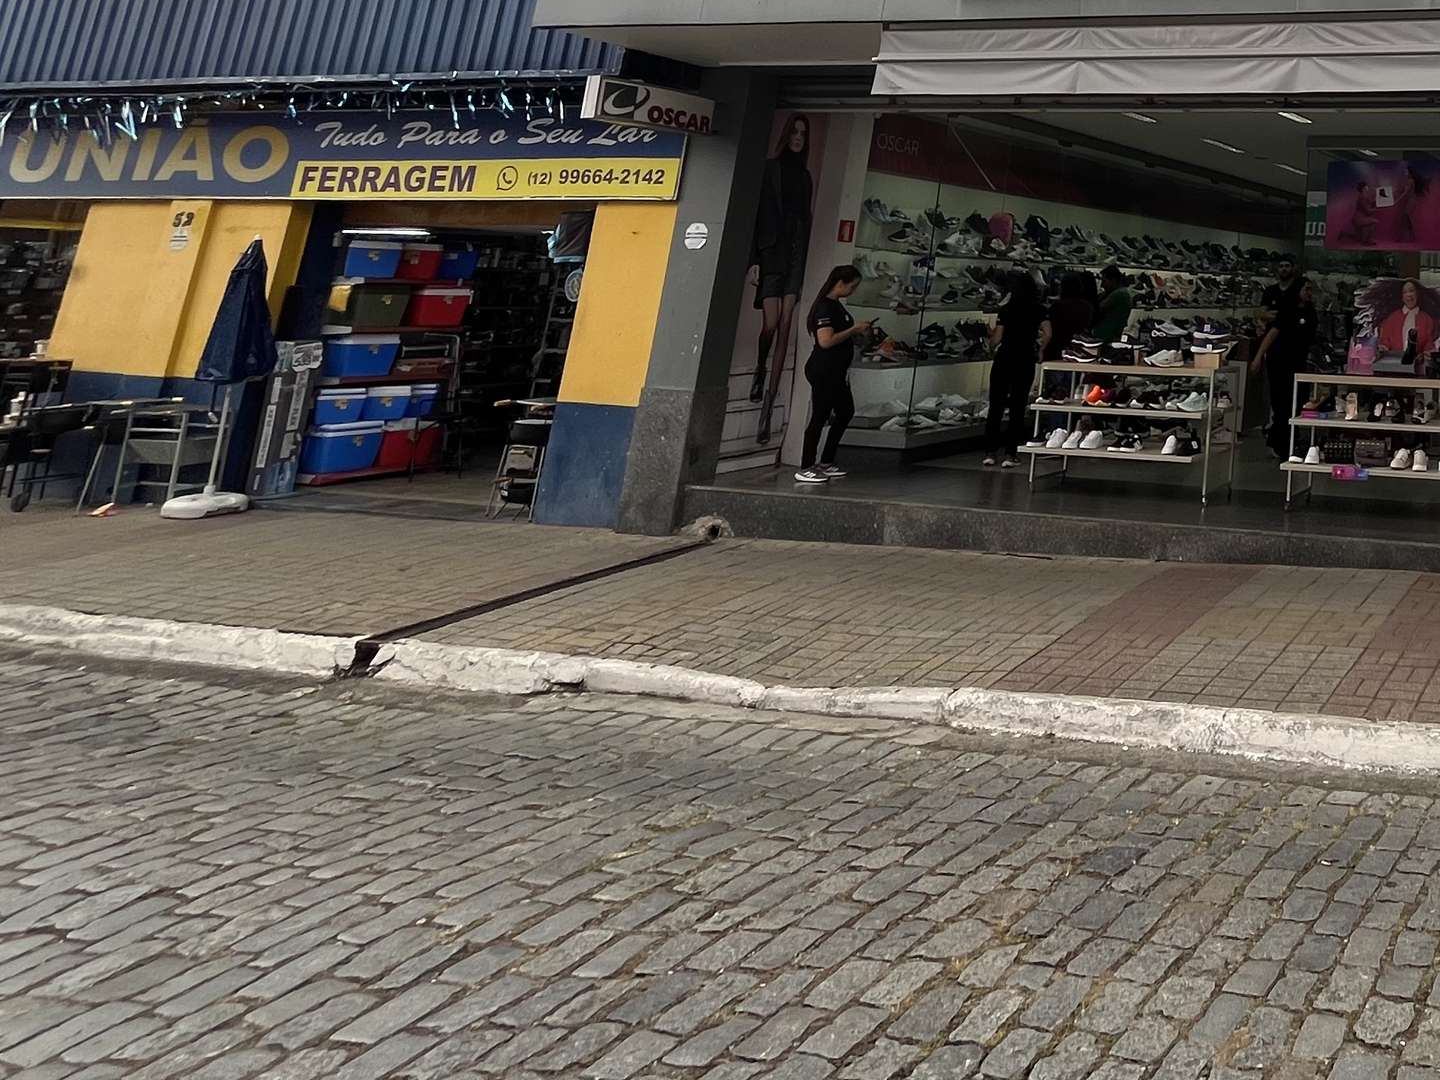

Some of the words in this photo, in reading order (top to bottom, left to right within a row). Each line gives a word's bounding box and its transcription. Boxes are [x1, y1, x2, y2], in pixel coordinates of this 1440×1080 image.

[647, 105, 710, 132] OSCAR
[314, 121, 388, 149] Tudo
[397, 120, 482, 149] Para
[489, 126, 508, 145] o
[517, 117, 584, 146] Seu
[299, 165, 477, 193] FERRAGEM
[527, 170, 553, 187] (12)
[558, 168, 666, 186] 99664-2142
